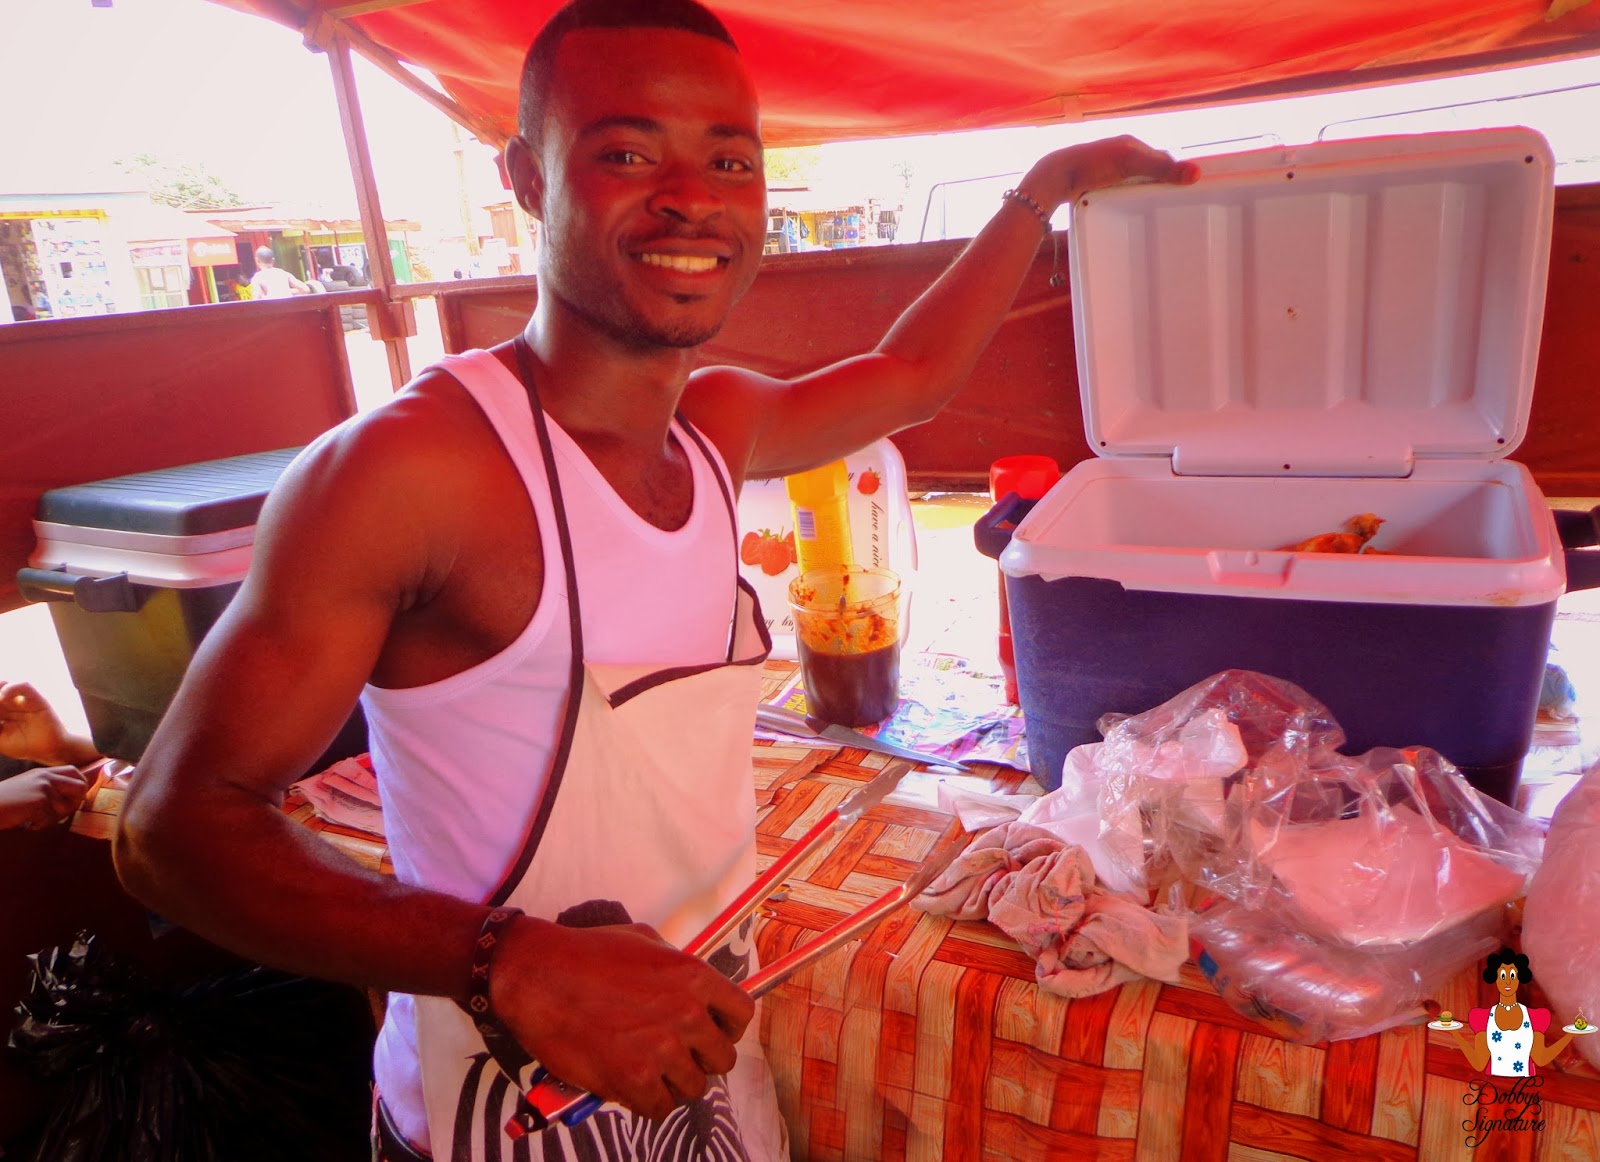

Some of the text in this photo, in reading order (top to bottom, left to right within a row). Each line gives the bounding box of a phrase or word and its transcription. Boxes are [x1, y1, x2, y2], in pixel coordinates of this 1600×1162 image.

[871, 501, 885, 567] have a nice
